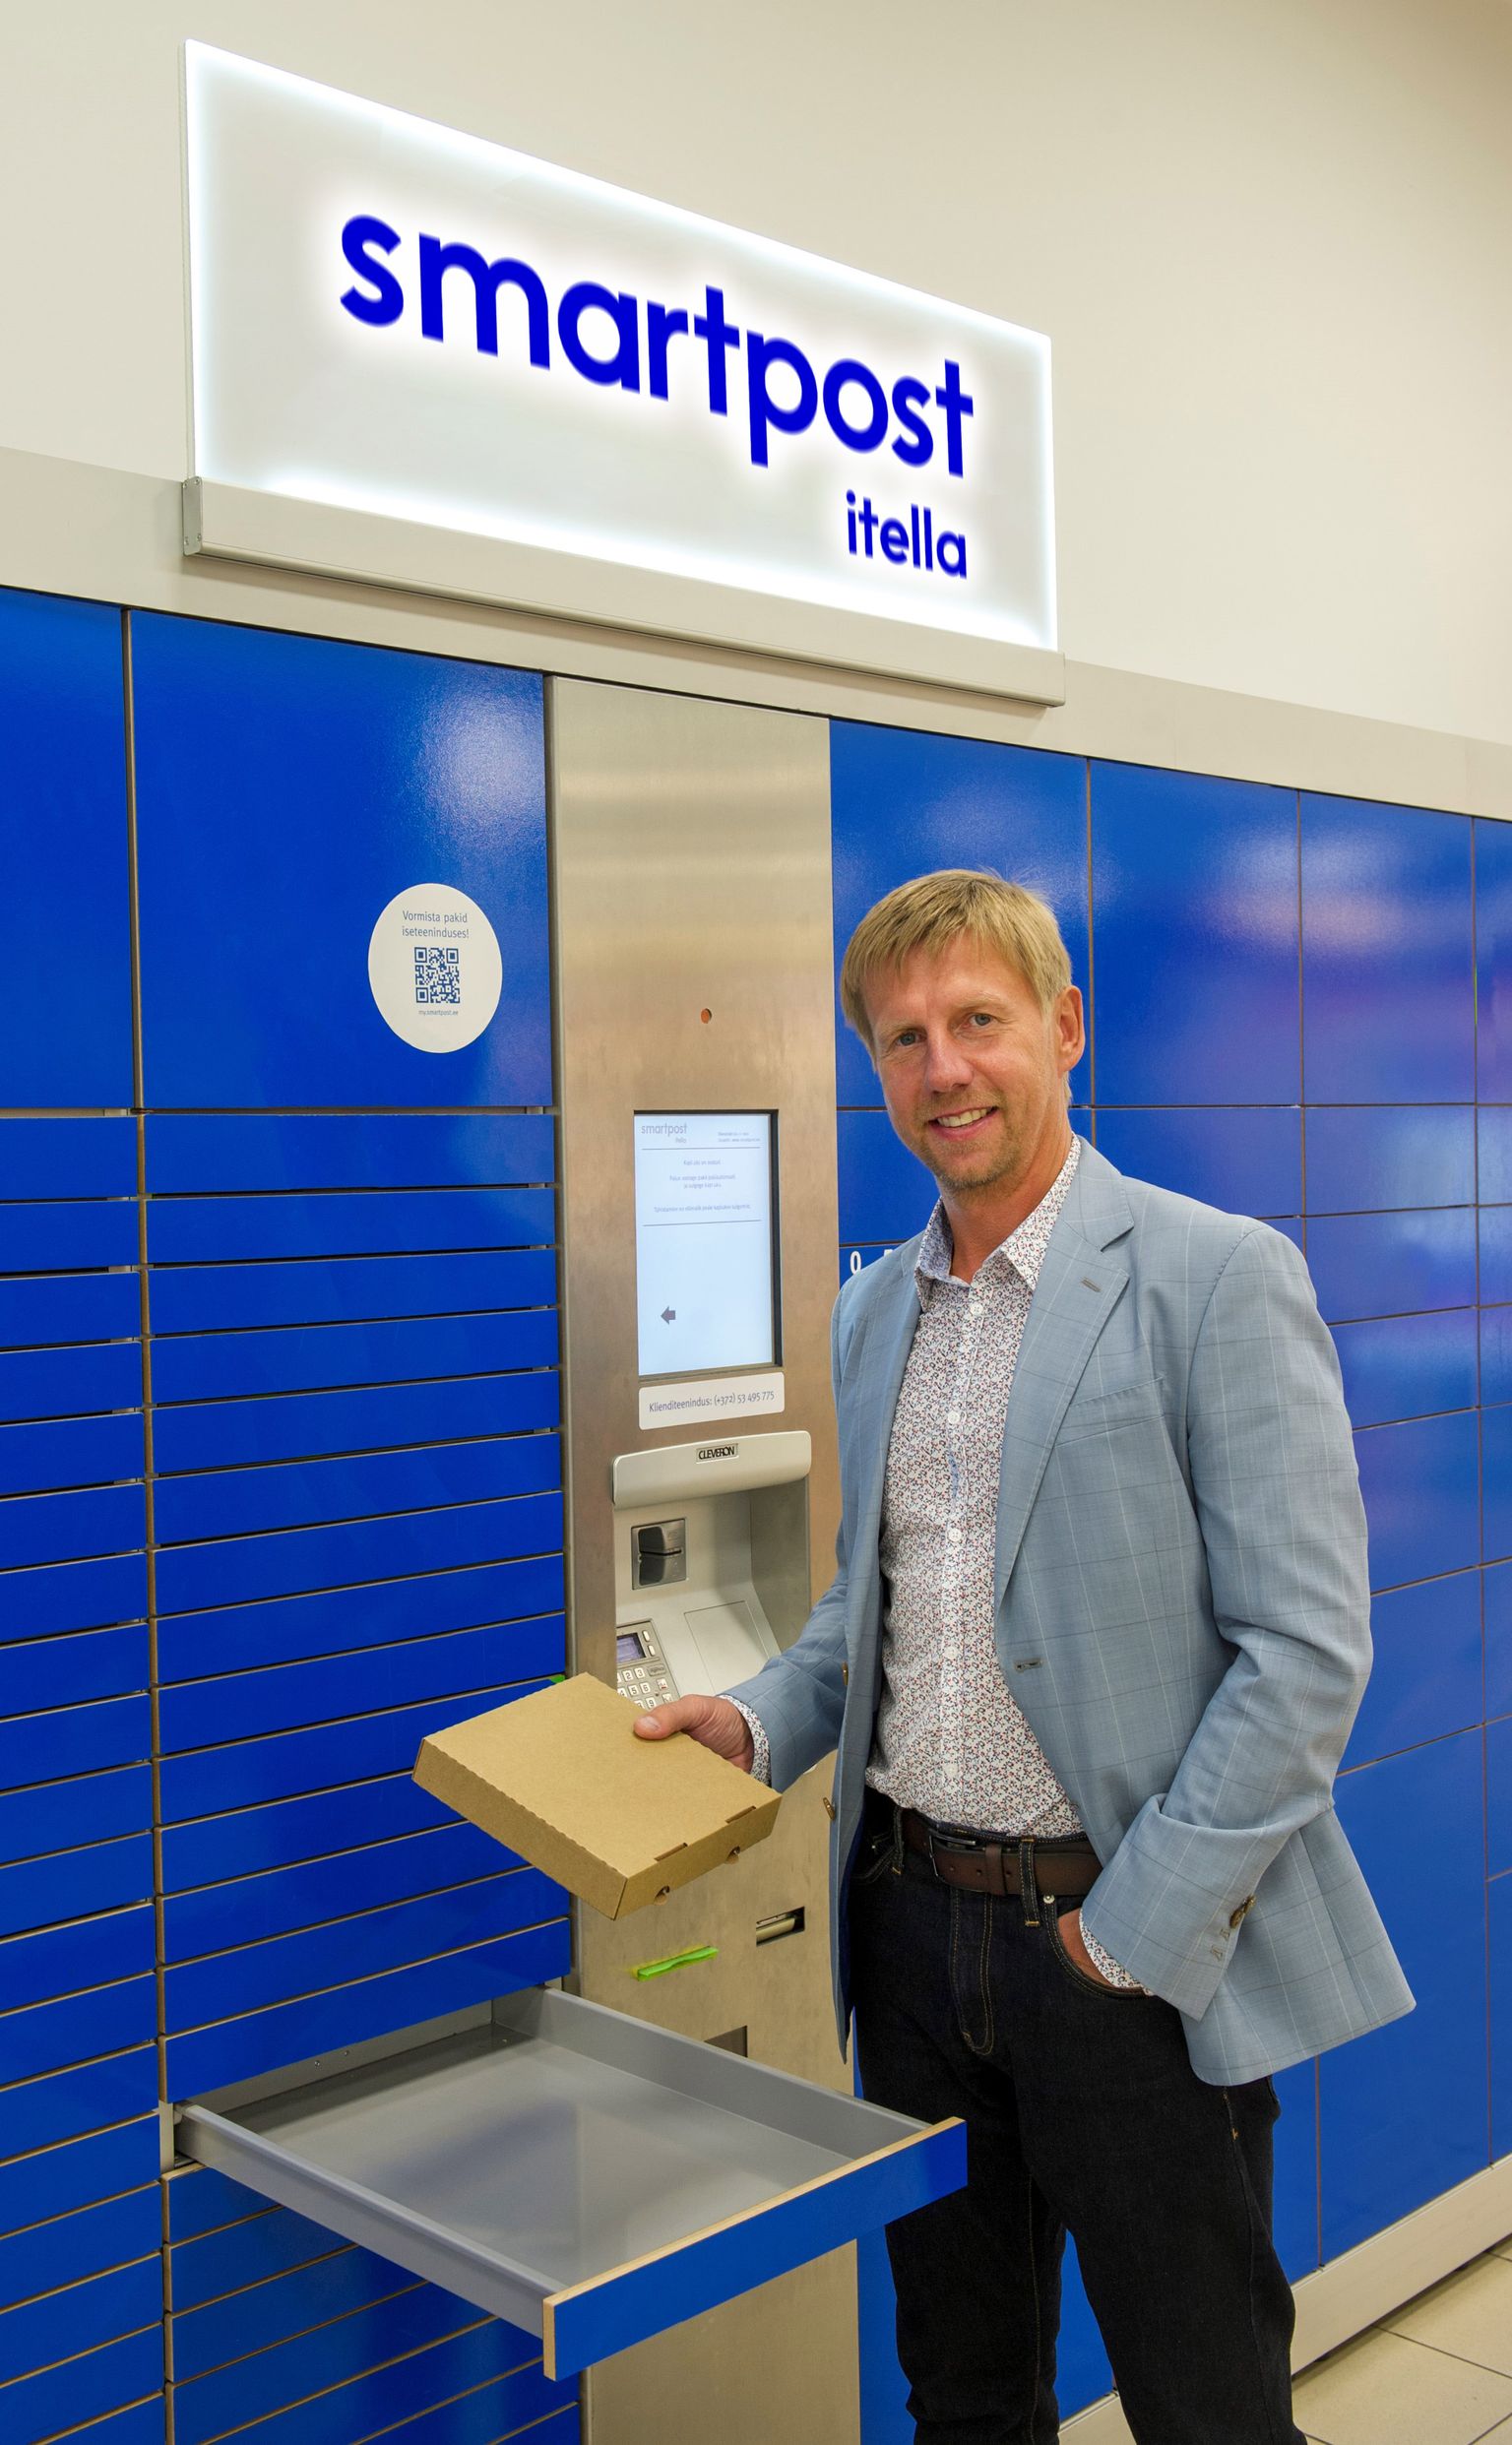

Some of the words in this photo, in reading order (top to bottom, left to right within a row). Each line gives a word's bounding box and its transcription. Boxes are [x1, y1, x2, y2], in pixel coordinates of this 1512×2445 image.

[340, 214, 974, 477] smartpost
[846, 490, 968, 579] itella
[403, 910, 441, 922] Vormista
[444, 912, 468, 924] pakid
[402, 925, 470, 938] iseteeninduses!
[641, 1122, 688, 1137] smartpost
[649, 1396, 713, 1412] Klienditeenindus:
[714, 1392, 736, 1407] (+372)
[737, 1394, 746, 1404] 53
[748, 1392, 761, 1403] 495
[762, 1390, 775, 1401] 775
[698, 1445, 735, 1460] CLEVERON
